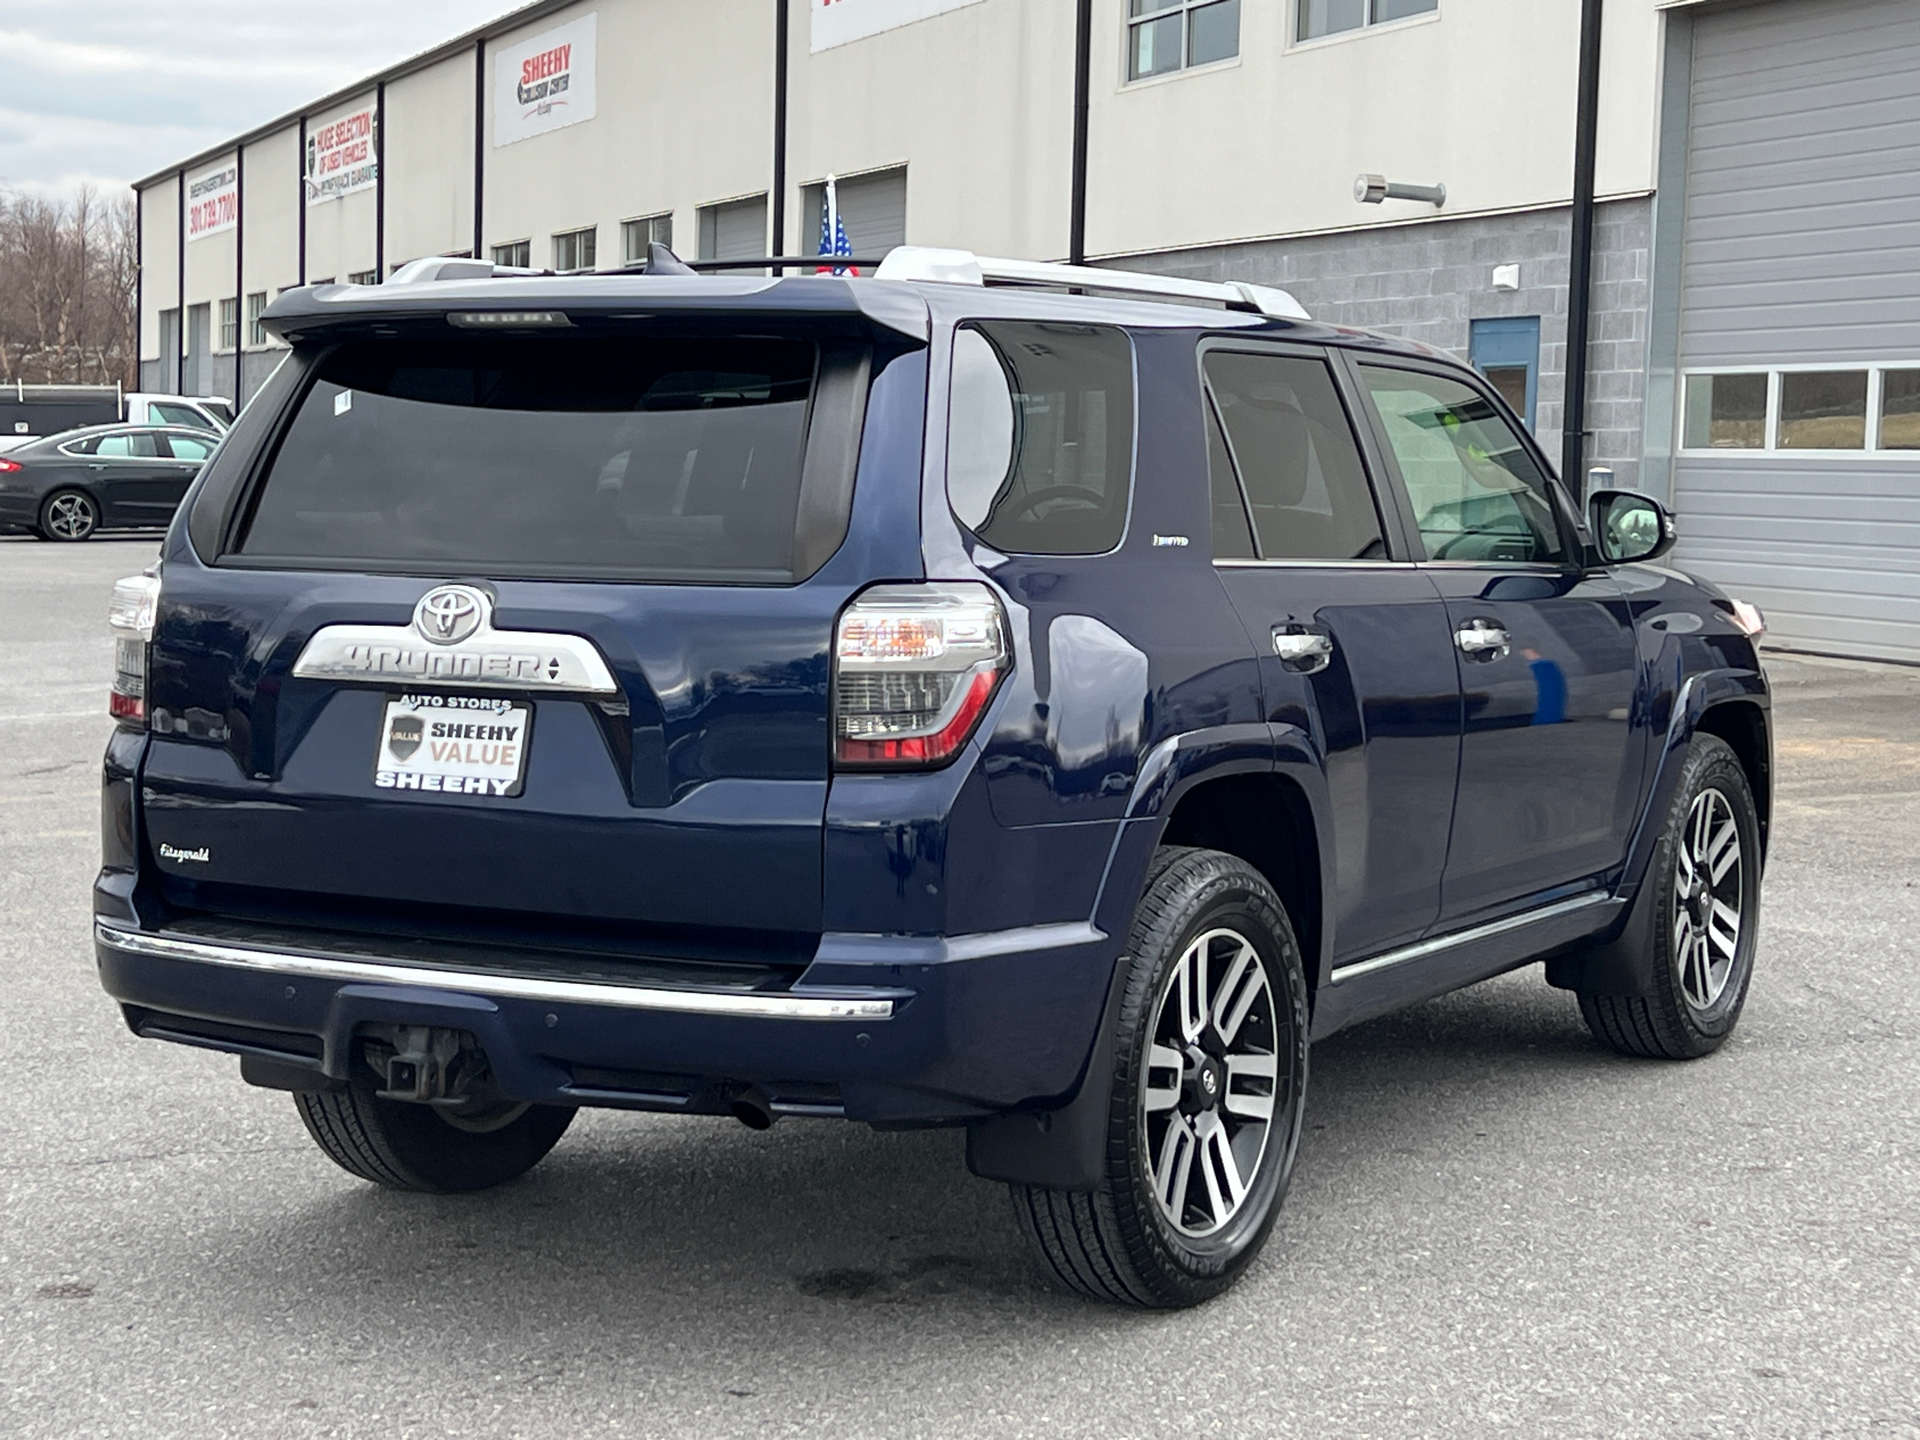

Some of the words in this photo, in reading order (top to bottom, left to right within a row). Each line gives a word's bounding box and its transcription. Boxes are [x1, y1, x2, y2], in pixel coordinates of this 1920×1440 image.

[522, 43, 571, 85] SHEEHY
[317, 126, 335, 154] HUGE
[336, 111, 371, 147] SELECTION
[344, 645, 540, 679] 4RUNNER
[400, 693, 443, 708] AUTO
[447, 696, 512, 711] STORES
[430, 722, 519, 741] SHEEHY
[430, 741, 516, 766] VALUE
[374, 771, 516, 796] SHEEHY
